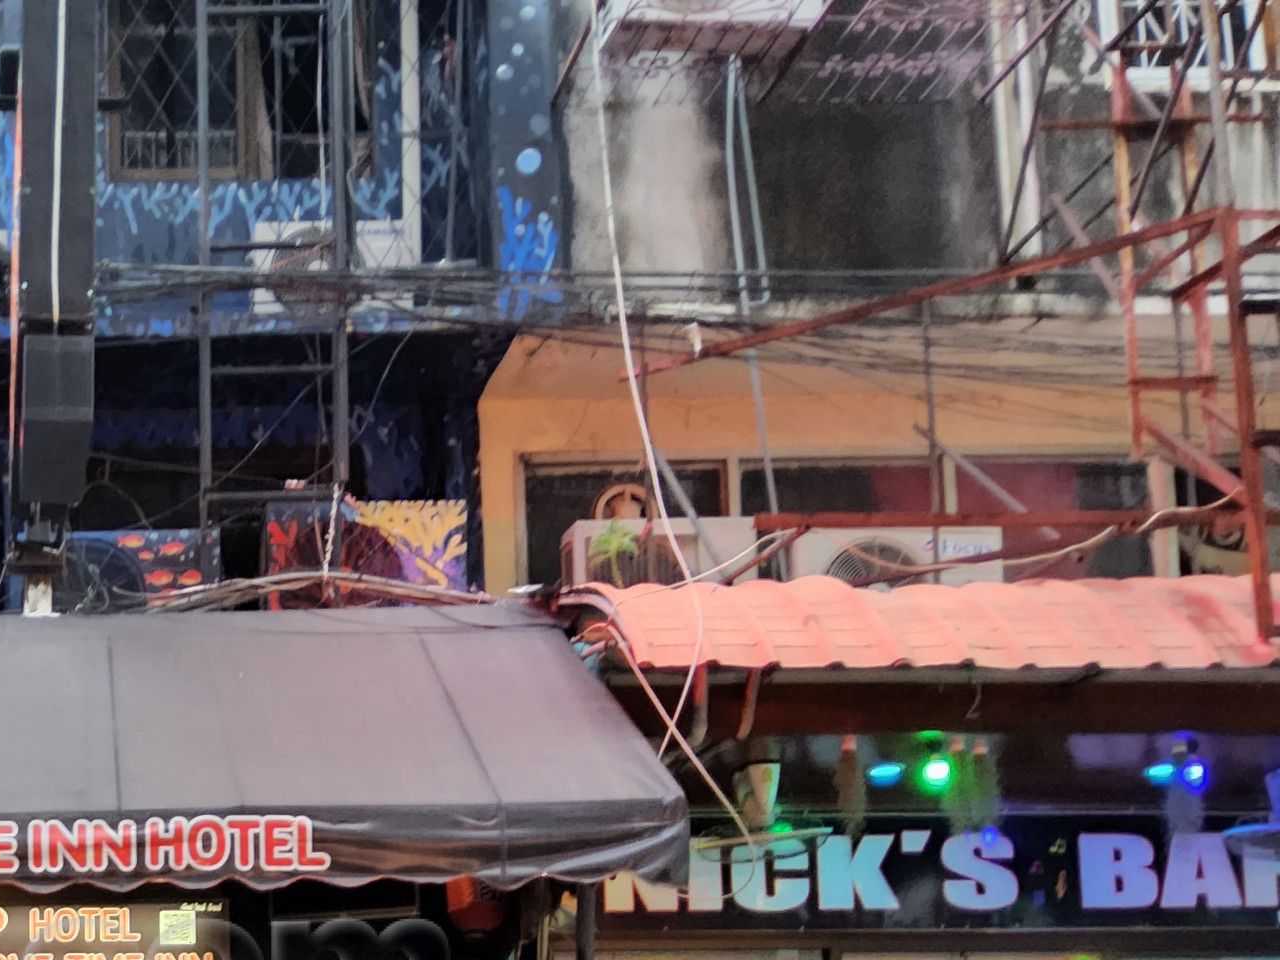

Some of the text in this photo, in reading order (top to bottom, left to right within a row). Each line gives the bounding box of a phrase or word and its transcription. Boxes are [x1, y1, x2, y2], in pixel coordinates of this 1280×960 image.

[27, 817, 134, 873] INN
[143, 814, 331, 874] HOTEL
[28, 906, 141, 942] HOTEL
